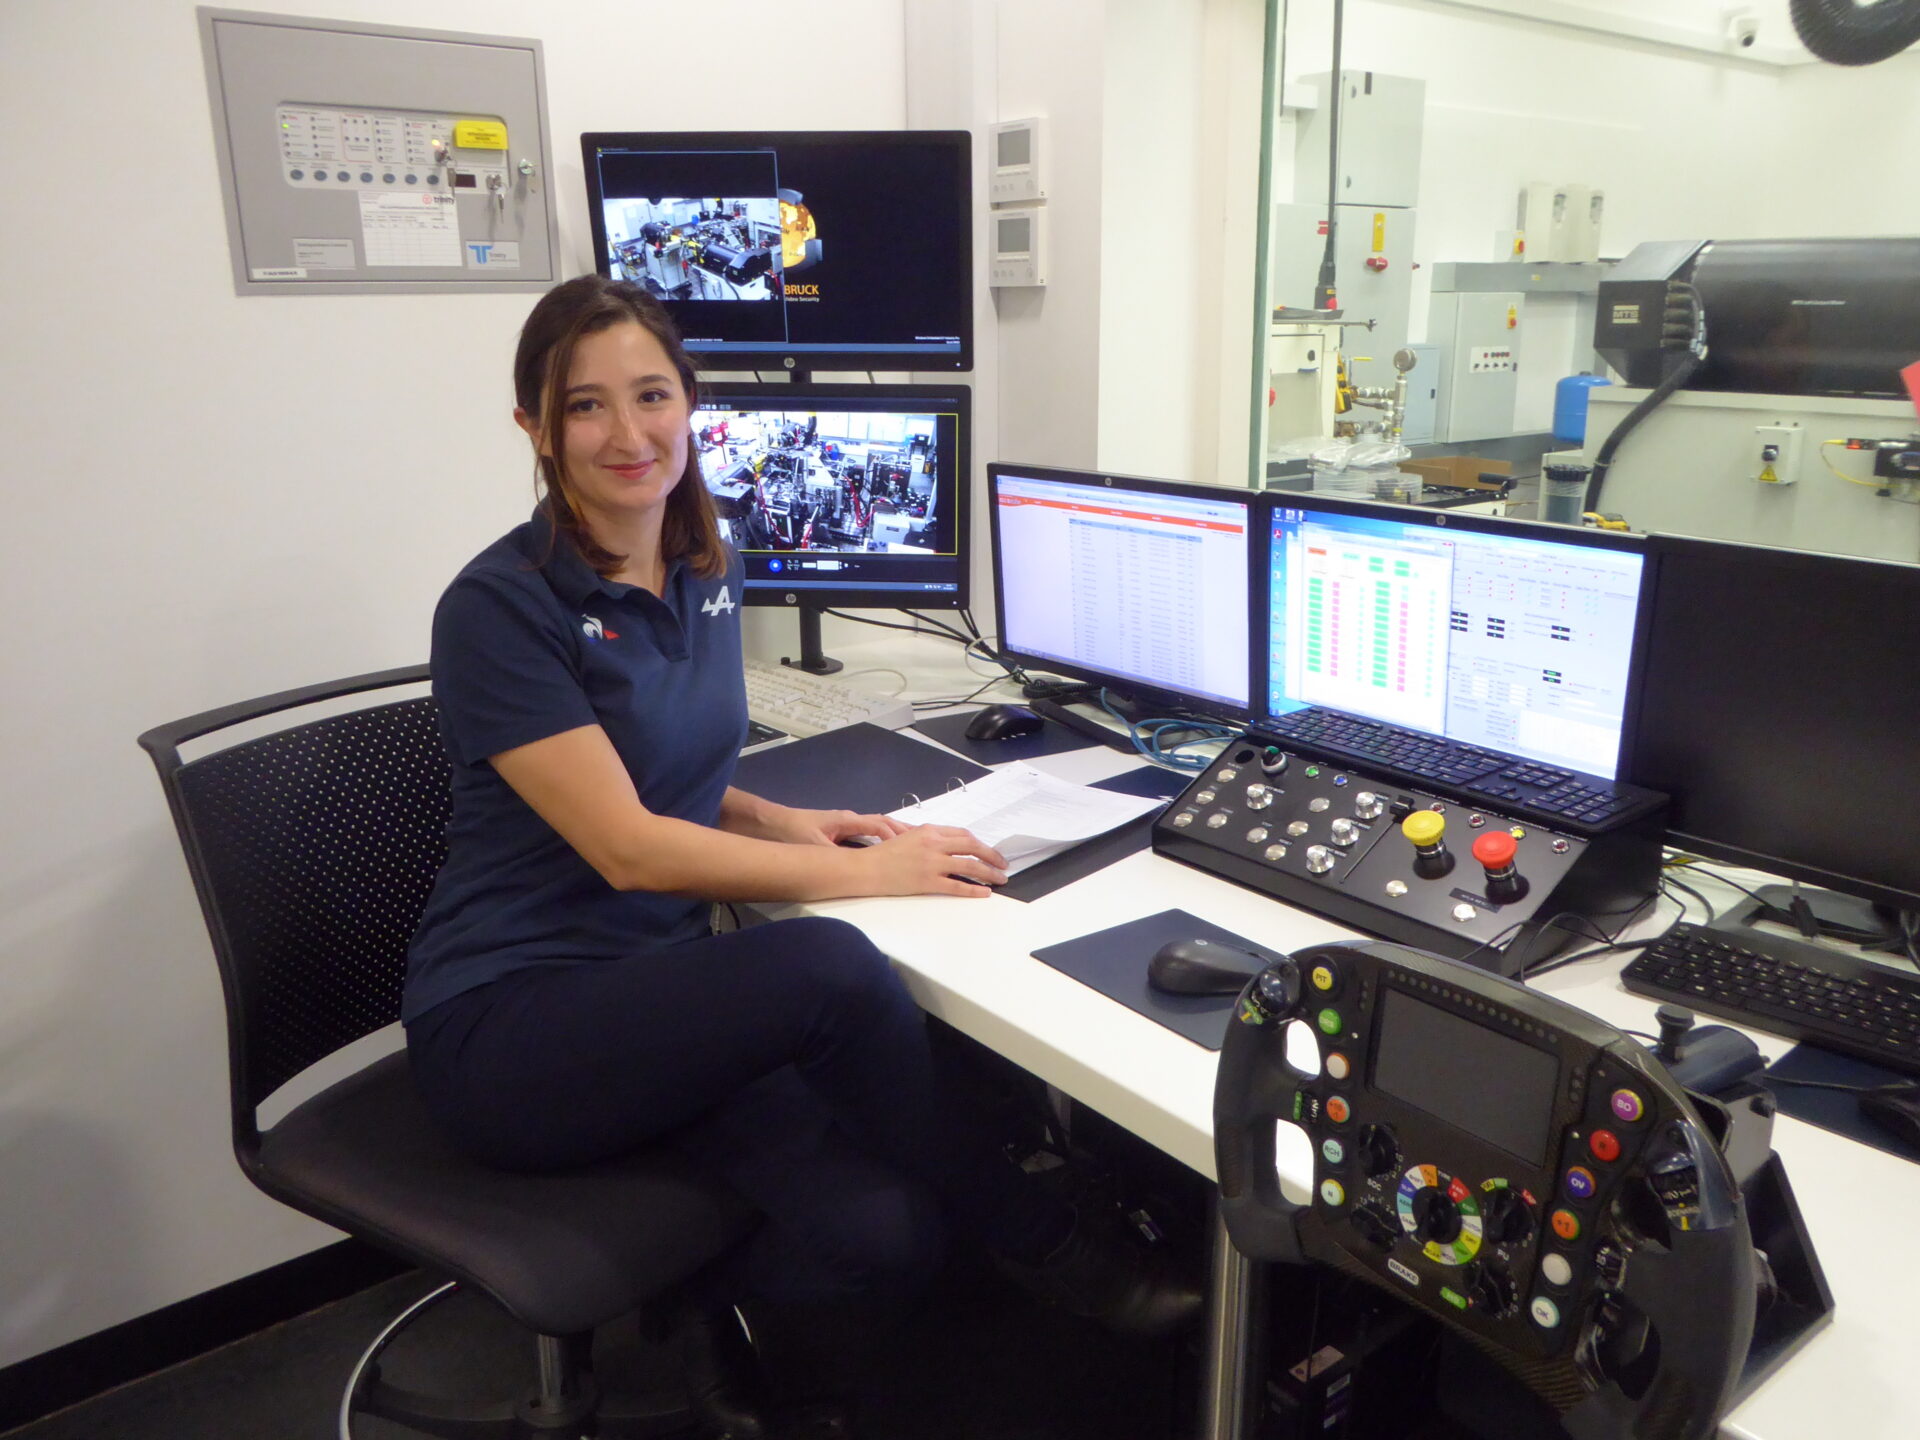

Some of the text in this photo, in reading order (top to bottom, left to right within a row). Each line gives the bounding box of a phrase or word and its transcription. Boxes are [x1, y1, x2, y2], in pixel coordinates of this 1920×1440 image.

[784, 284, 819, 295] BRUCK
[1613, 310, 1638, 319] MTS
[1315, 973, 1328, 984] PIT
[1324, 1145, 1340, 1157] RCH
[1367, 1177, 1382, 1191] SOC
[1390, 1261, 1418, 1282] BRAKE
